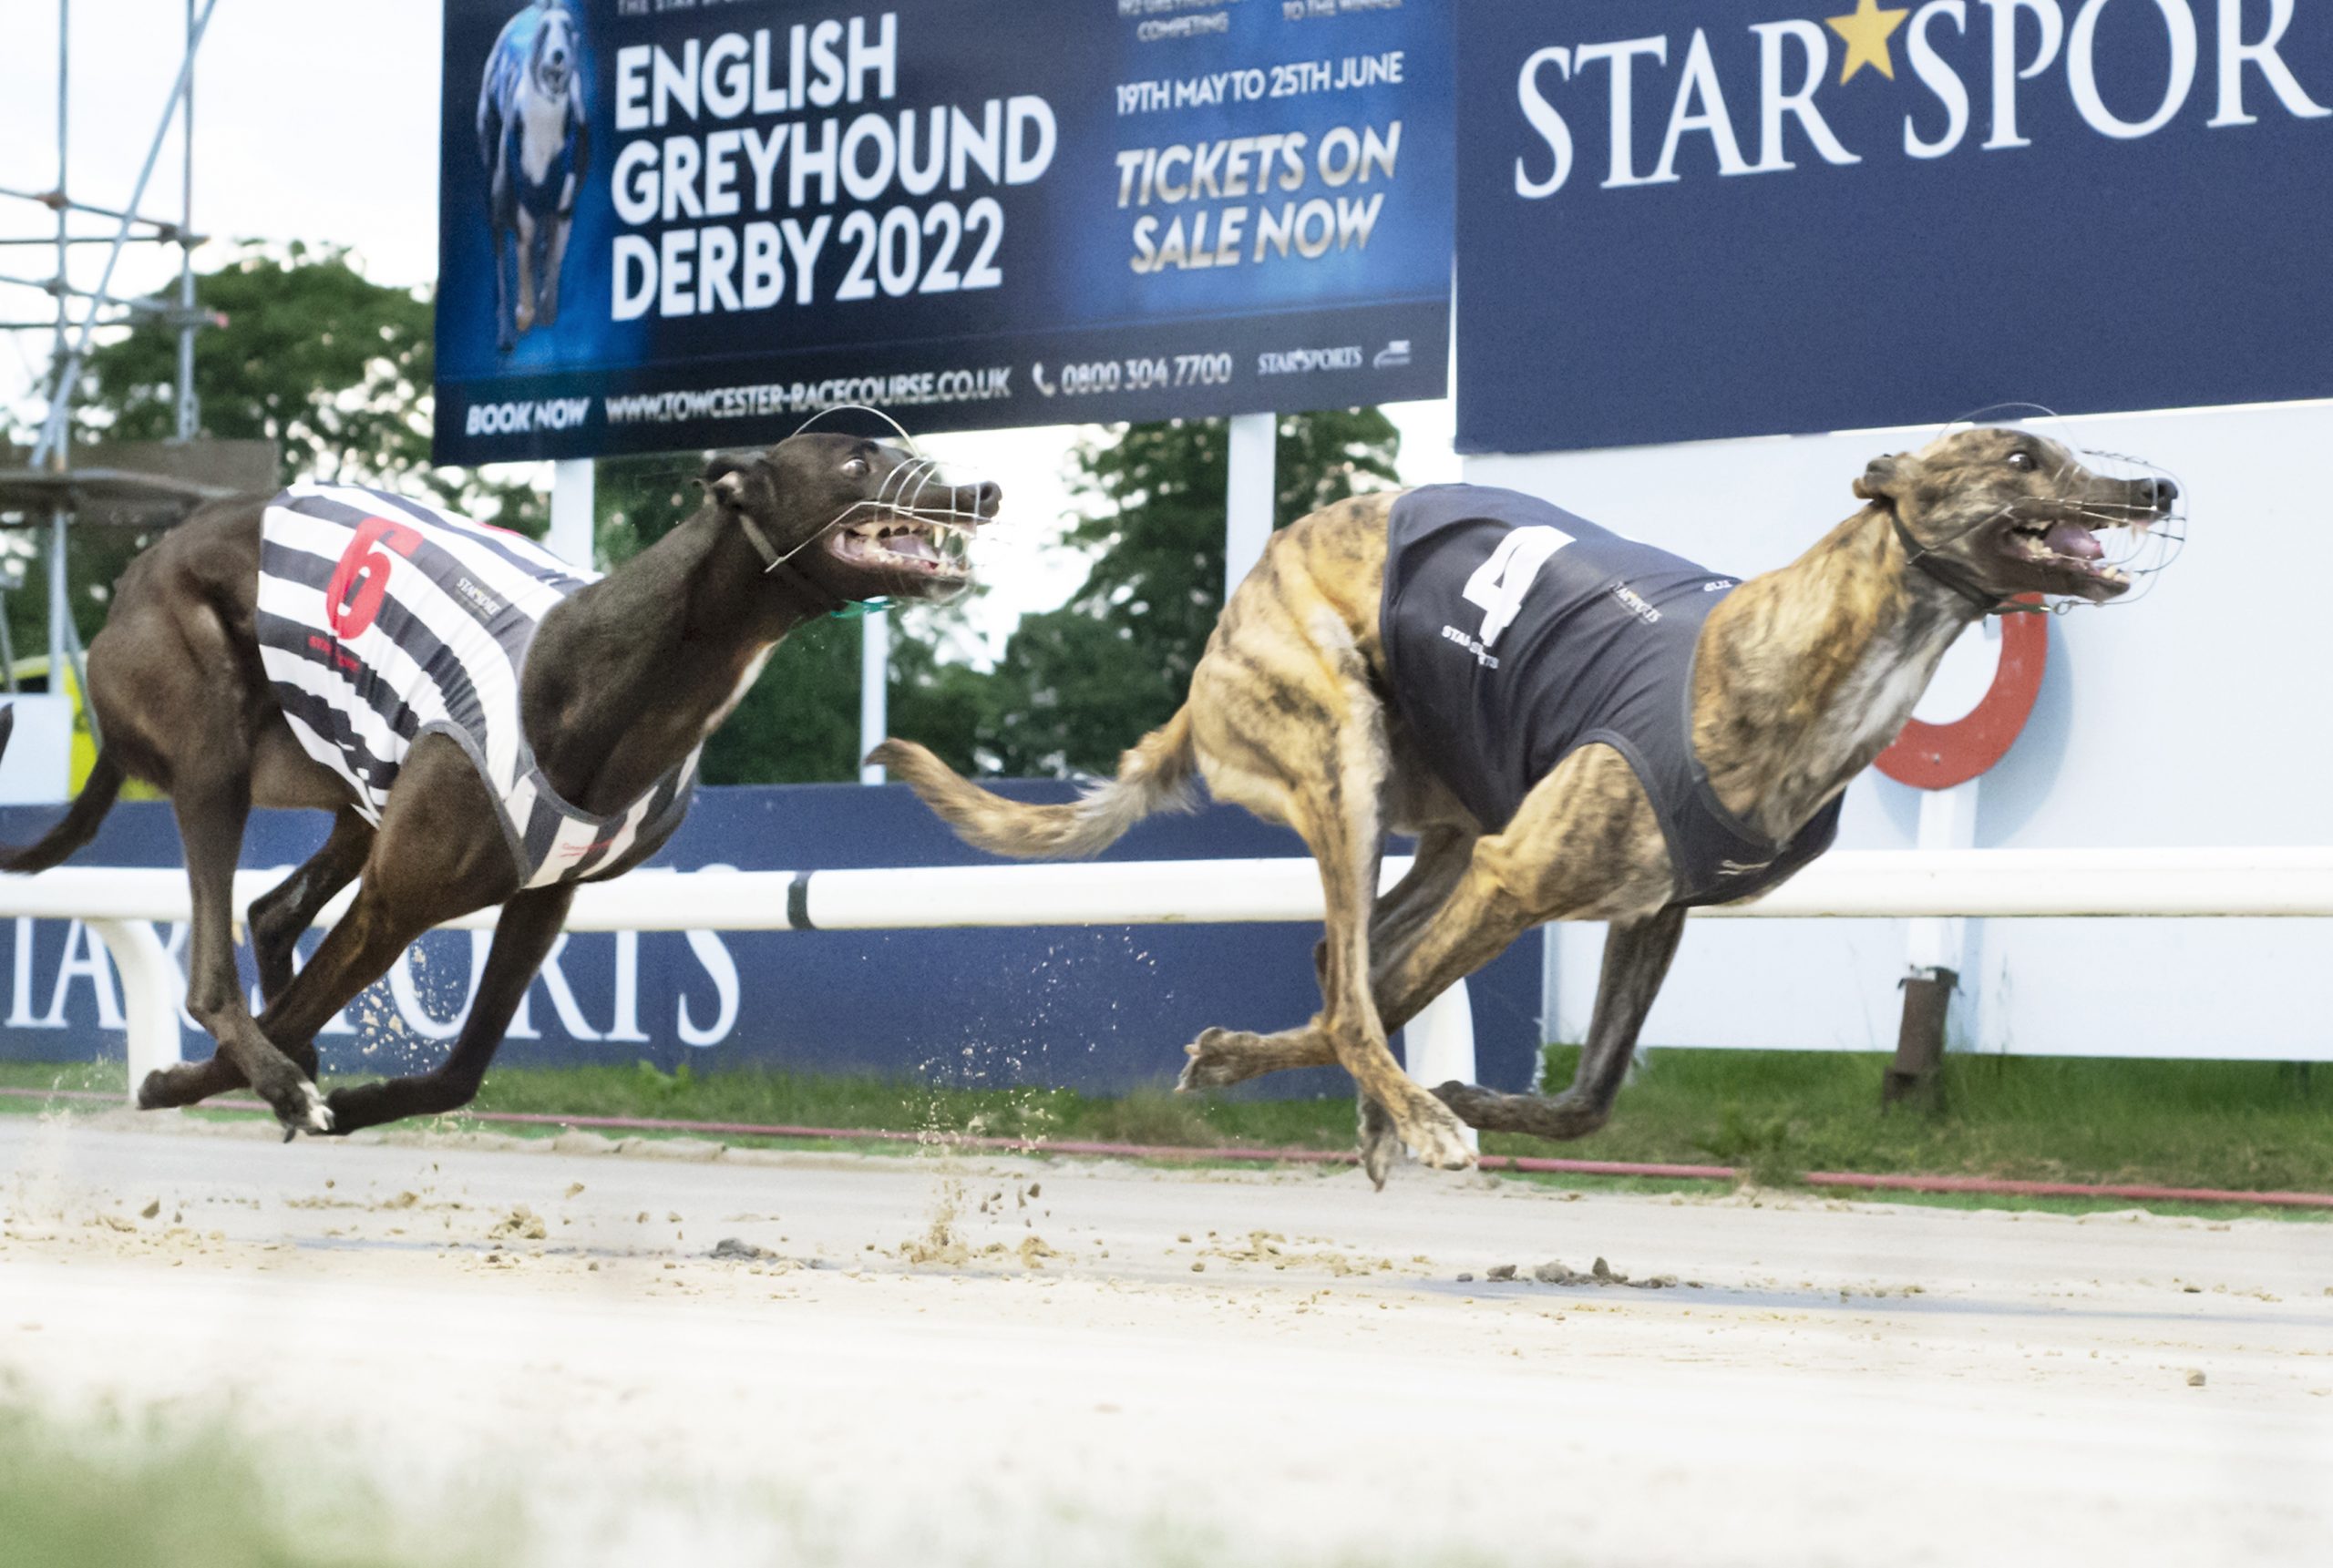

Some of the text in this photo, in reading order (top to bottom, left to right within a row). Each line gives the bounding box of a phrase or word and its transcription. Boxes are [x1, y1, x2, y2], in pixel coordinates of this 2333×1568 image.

[614, 12, 897, 130] ENGLISH
[1115, 51, 1405, 116] 19TH MAY TO 25TH JUNE
[1514, 18, 1862, 200] STAR
[611, 95, 1057, 226] GREYHOUND
[1115, 120, 1402, 209] TICKETS ON
[612, 196, 1003, 322] DERBY 2022
[1129, 193, 1384, 274] SALE NOW
[466, 397, 591, 436] BOOK NOW
[1061, 352, 1233, 395] 0800 304 7700
[325, 516, 424, 641] 6
[1462, 525, 1577, 648] 4
